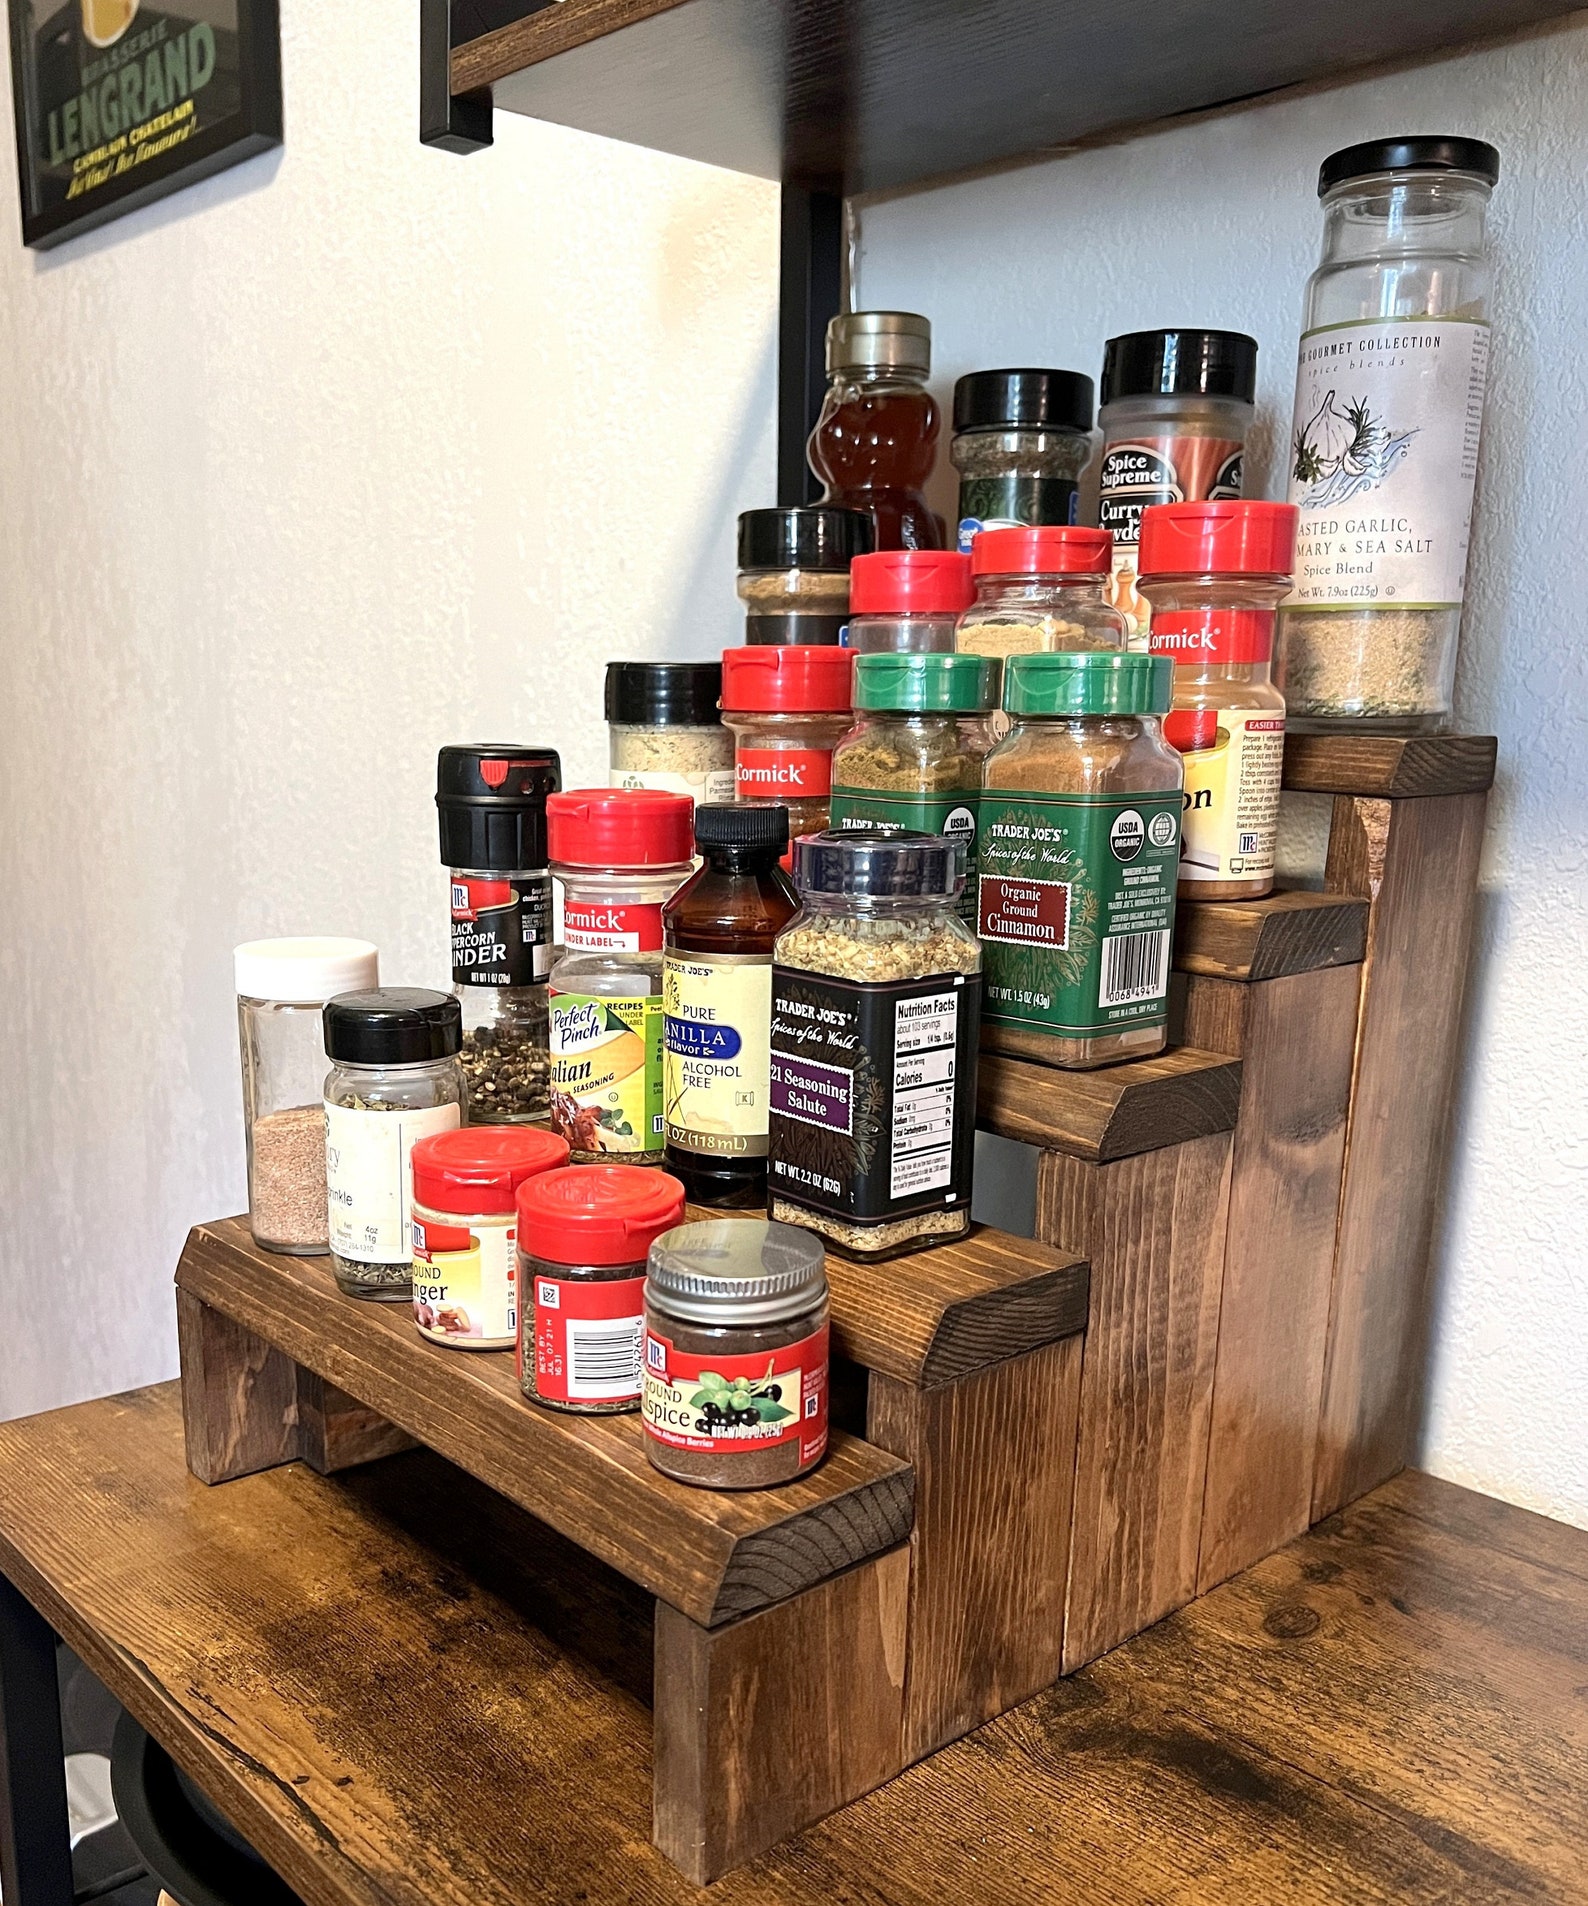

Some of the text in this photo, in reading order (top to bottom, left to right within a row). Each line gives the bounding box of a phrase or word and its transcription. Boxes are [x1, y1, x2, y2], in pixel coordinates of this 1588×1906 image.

[48, 21, 216, 167] LENGRAND
[1308, 336, 1441, 364] GOURMET COLLECTION
[1349, 357, 1405, 371] blends
[1108, 454, 1148, 472] Spice
[1101, 469, 1162, 488] Supreme
[1101, 500, 1148, 524] Curry
[1298, 519, 1412, 538] ASTED GARLIC,
[1297, 539, 1432, 558] MARY & SEA SALT
[1303, 561, 1373, 578] Spice Blend
[1298, 585, 1309, 598] Net
[1350, 583, 1378, 597] (225g)
[1151, 628, 1218, 651] ormick
[1249, 721, 1274, 730] EASIER
[737, 763, 804, 785] Cormick
[842, 817, 873, 830] TRADER
[951, 819, 969, 832] USDA
[991, 824, 1062, 842] TRADER JOE'S
[1118, 821, 1138, 834] USDA
[1114, 837, 1141, 848] ORGANIC
[982, 842, 1076, 866] Spices of the World
[1001, 882, 1041, 902] Organic
[1002, 900, 1038, 918] Ground
[565, 909, 624, 932] ormick
[987, 912, 1055, 940] Cinnamon
[566, 933, 614, 947] NDER LABEL
[452, 943, 507, 967] INDER
[688, 966, 710, 977] JOE'S
[1013, 989, 1023, 1003] 1.5
[1023, 991, 1033, 1004] OZ
[1033, 993, 1051, 1010] (43g)
[1109, 985, 1155, 1002] 0068 4941
[607, 1003, 644, 1011] RECIPES
[620, 1011, 644, 1019] UNDER
[683, 1005, 717, 1021] PURE
[775, 998, 847, 1027] TRADER JOE'S
[898, 998, 955, 1019] Nutrition Facts
[554, 1004, 598, 1032] Perfect
[921, 1019, 941, 1031] servings
[561, 1016, 599, 1051] Pinch
[665, 1022, 726, 1046] ANILLA
[770, 1017, 860, 1050] Spices of the World
[896, 1039, 912, 1049] Serving
[551, 1060, 592, 1083] alian
[682, 1061, 743, 1078] ALCOHOL
[895, 1060, 954, 1087] Calories 0
[573, 1072, 615, 1094] SEASONING
[683, 1075, 712, 1089] FREE
[770, 1063, 849, 1104] 21 Seasoning
[787, 1090, 828, 1117] Salute
[672, 1128, 687, 1144] OZ
[774, 1160, 788, 1176] NET
[800, 1169, 812, 1185] 2.2
[812, 1172, 822, 1189] OZ
[822, 1176, 841, 1198] (62G)
[328, 1186, 353, 1207] rinkle
[413, 1265, 441, 1279] OUND
[413, 1282, 449, 1306] nger
[546, 1329, 554, 1340] 21
[539, 1335, 547, 1374] BEST BY
[546, 1342, 553, 1355] 07
[645, 1377, 682, 1403] ROUND
[643, 1389, 691, 1427] llspice
